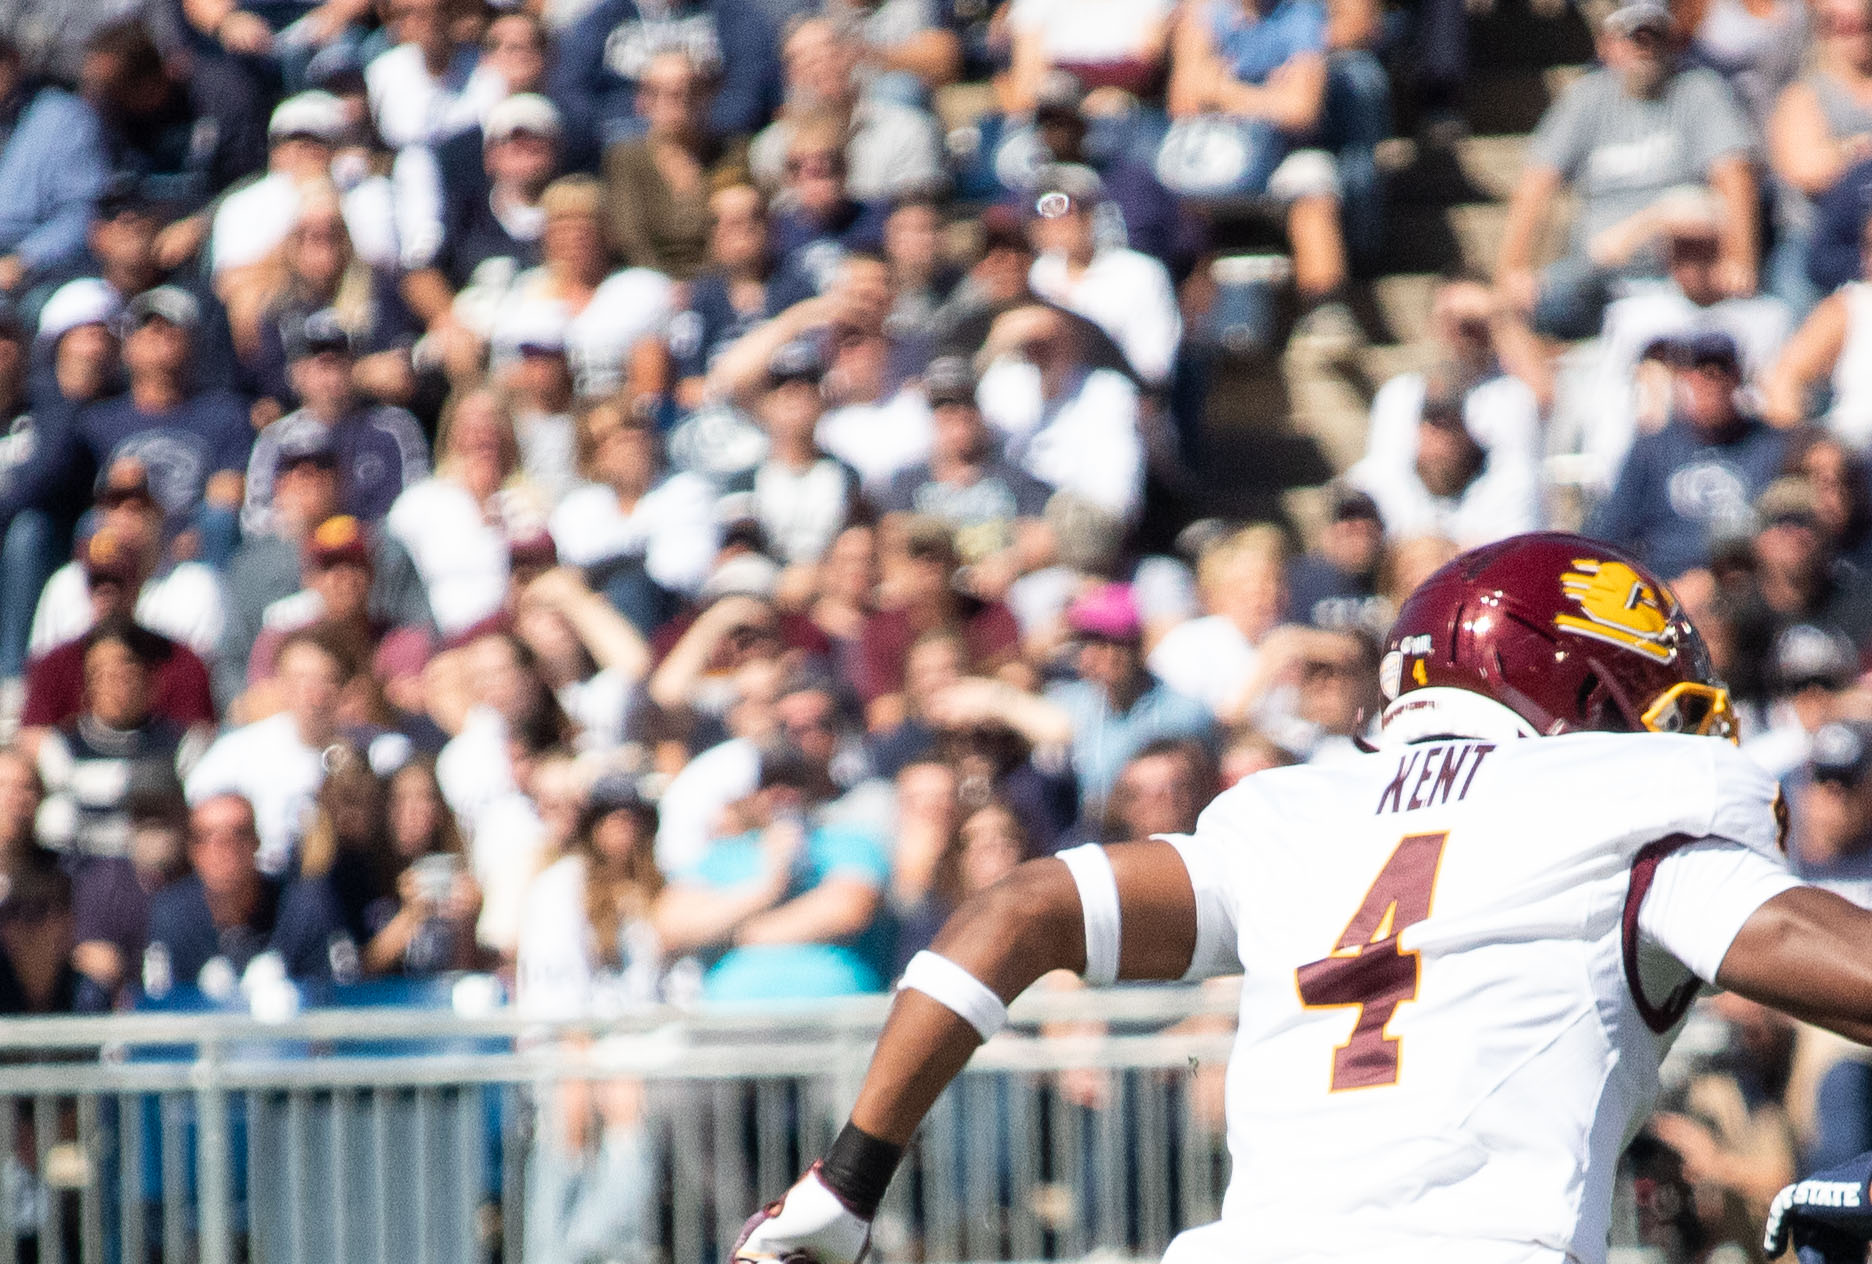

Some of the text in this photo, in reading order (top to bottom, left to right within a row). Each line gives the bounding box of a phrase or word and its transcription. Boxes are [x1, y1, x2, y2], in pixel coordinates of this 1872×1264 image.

[1375, 744, 1497, 815] KENT
[1293, 830, 1450, 1094] 4
[1793, 1179, 1862, 1208] STATE
